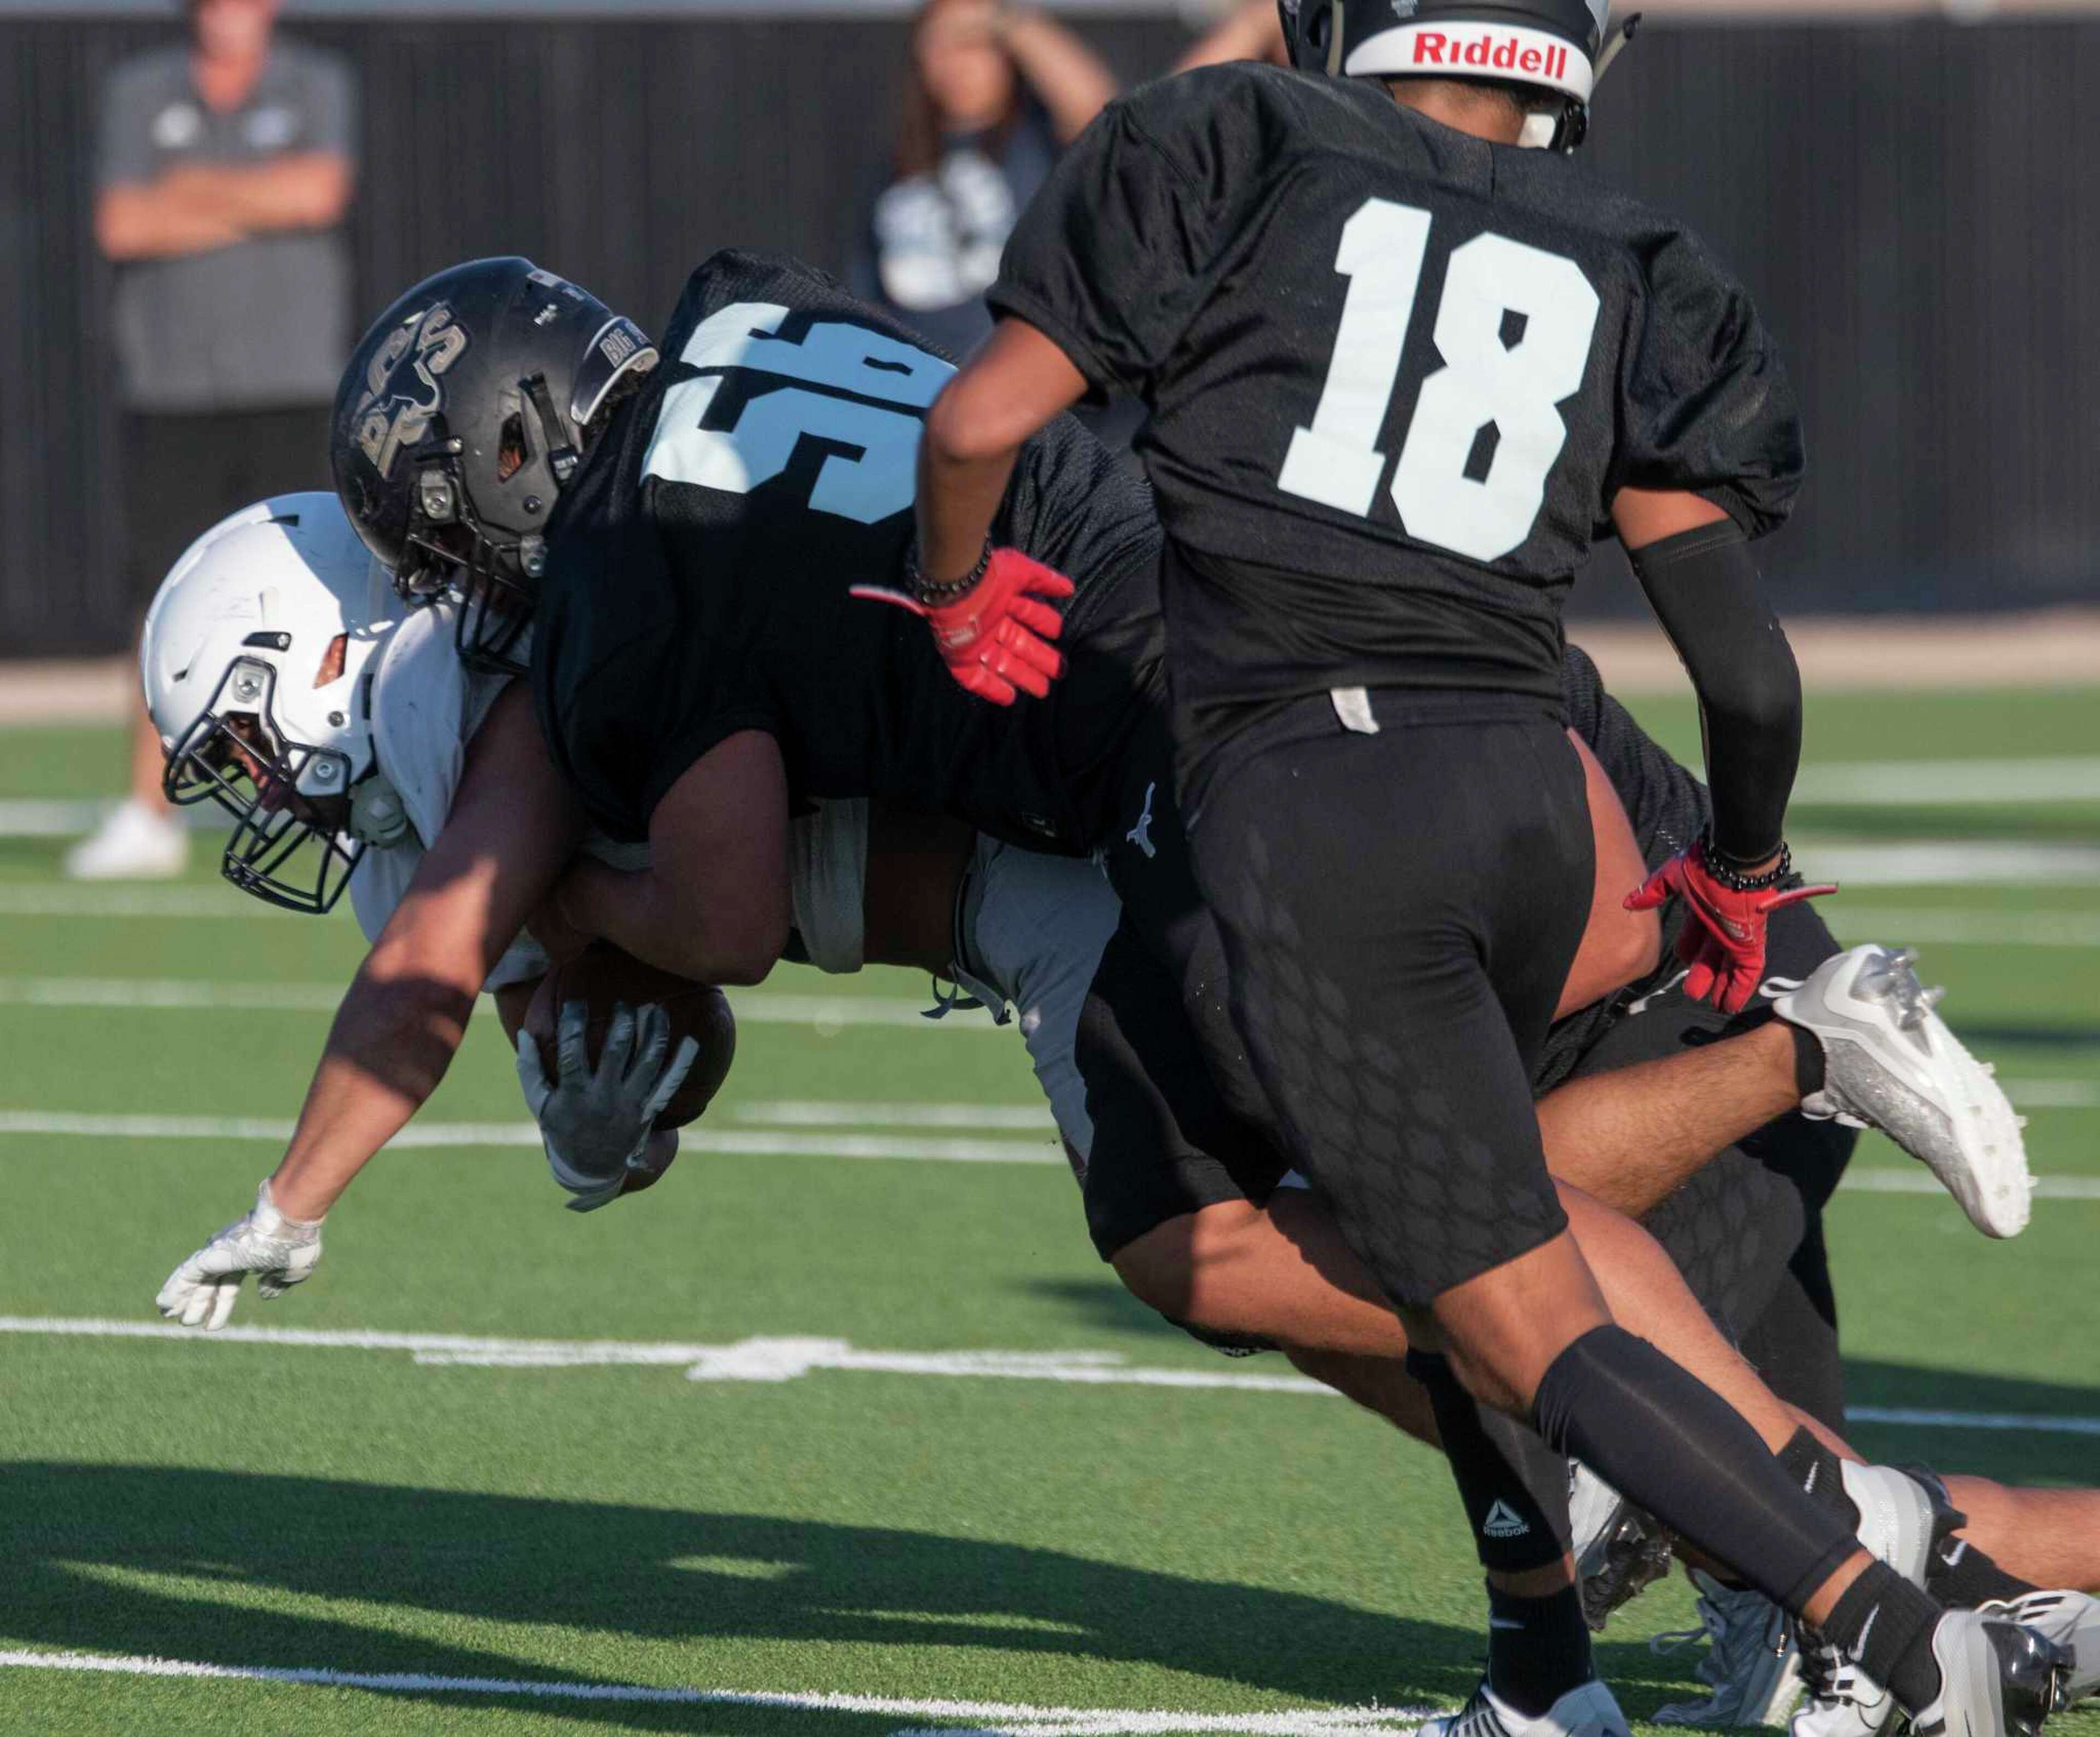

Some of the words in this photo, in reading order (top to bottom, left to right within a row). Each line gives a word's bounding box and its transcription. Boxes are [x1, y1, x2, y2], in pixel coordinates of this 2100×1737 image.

[1412, 32, 1567, 80] Riddell
[639, 302, 960, 525] 56
[1277, 197, 1600, 562] 18
